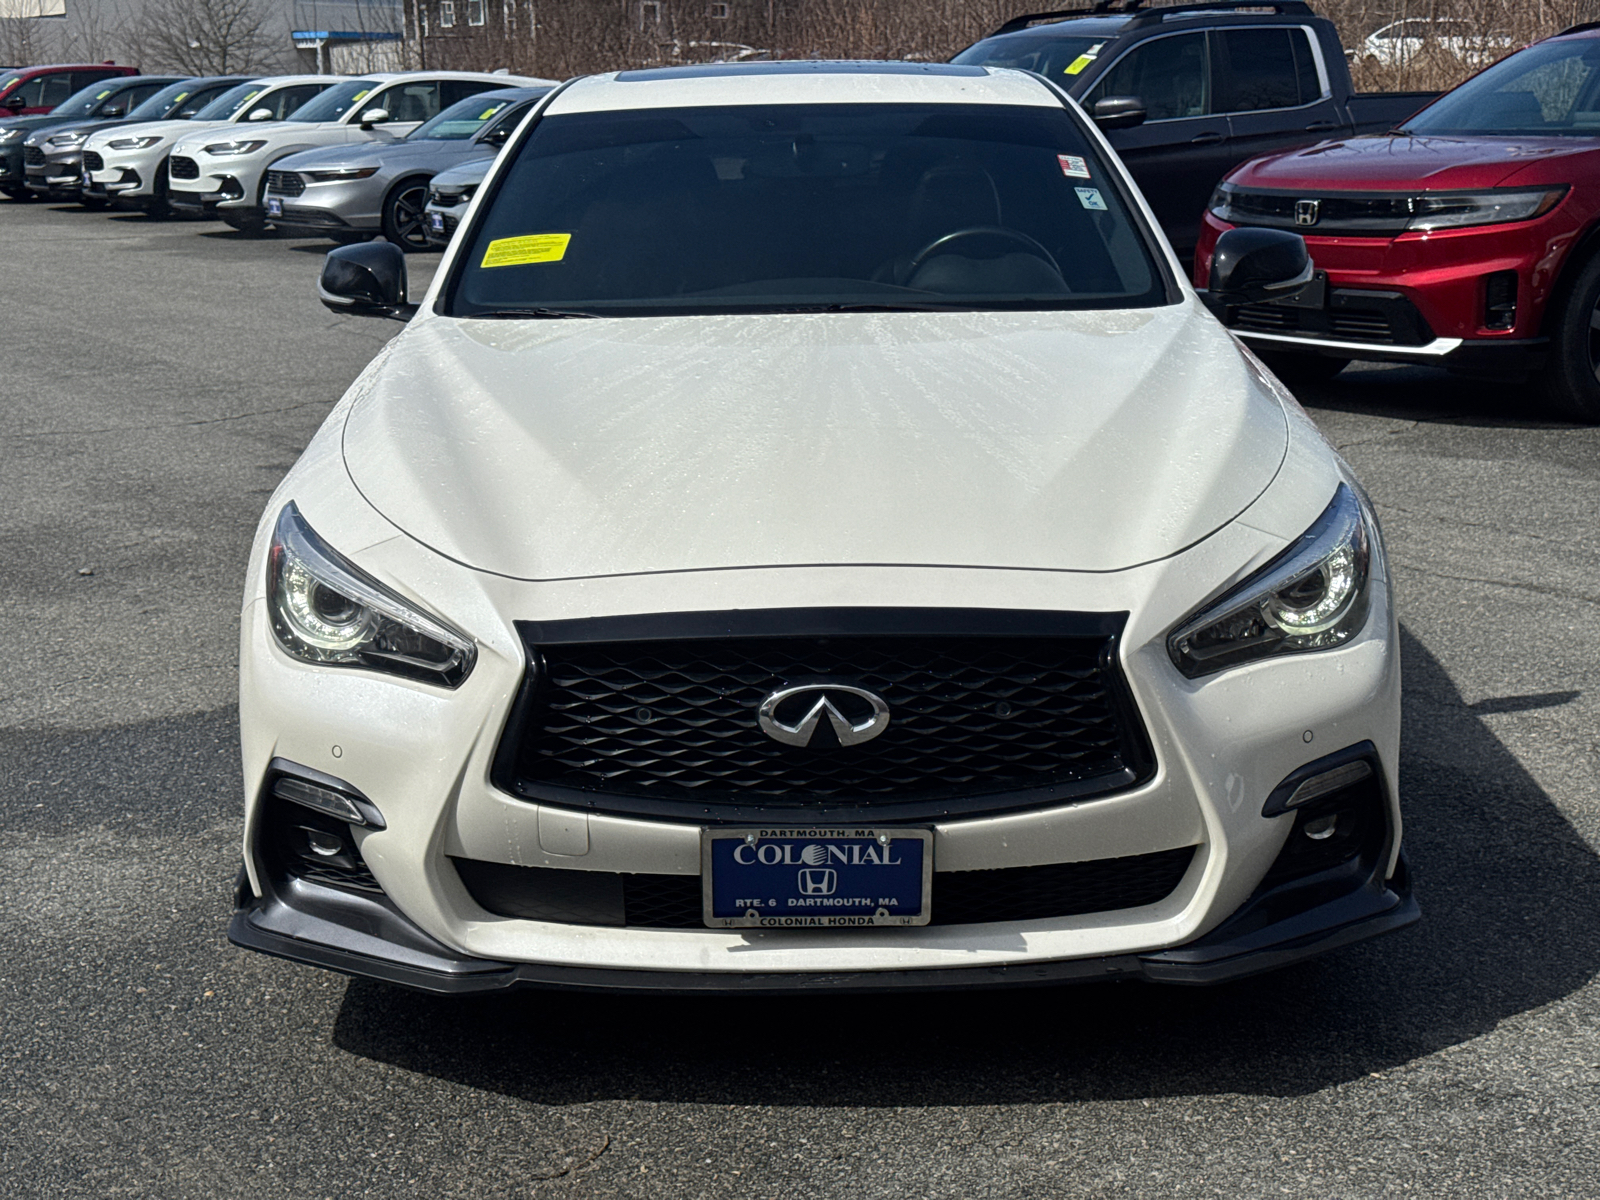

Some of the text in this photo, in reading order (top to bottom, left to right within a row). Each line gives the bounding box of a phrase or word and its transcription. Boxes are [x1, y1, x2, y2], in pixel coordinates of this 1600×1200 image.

[734, 844, 902, 866] COLONIAL
[736, 898, 898, 907] RTE. 6 DARTMOUTH, MA
[760, 917, 875, 926] COLONIAL HONDA
